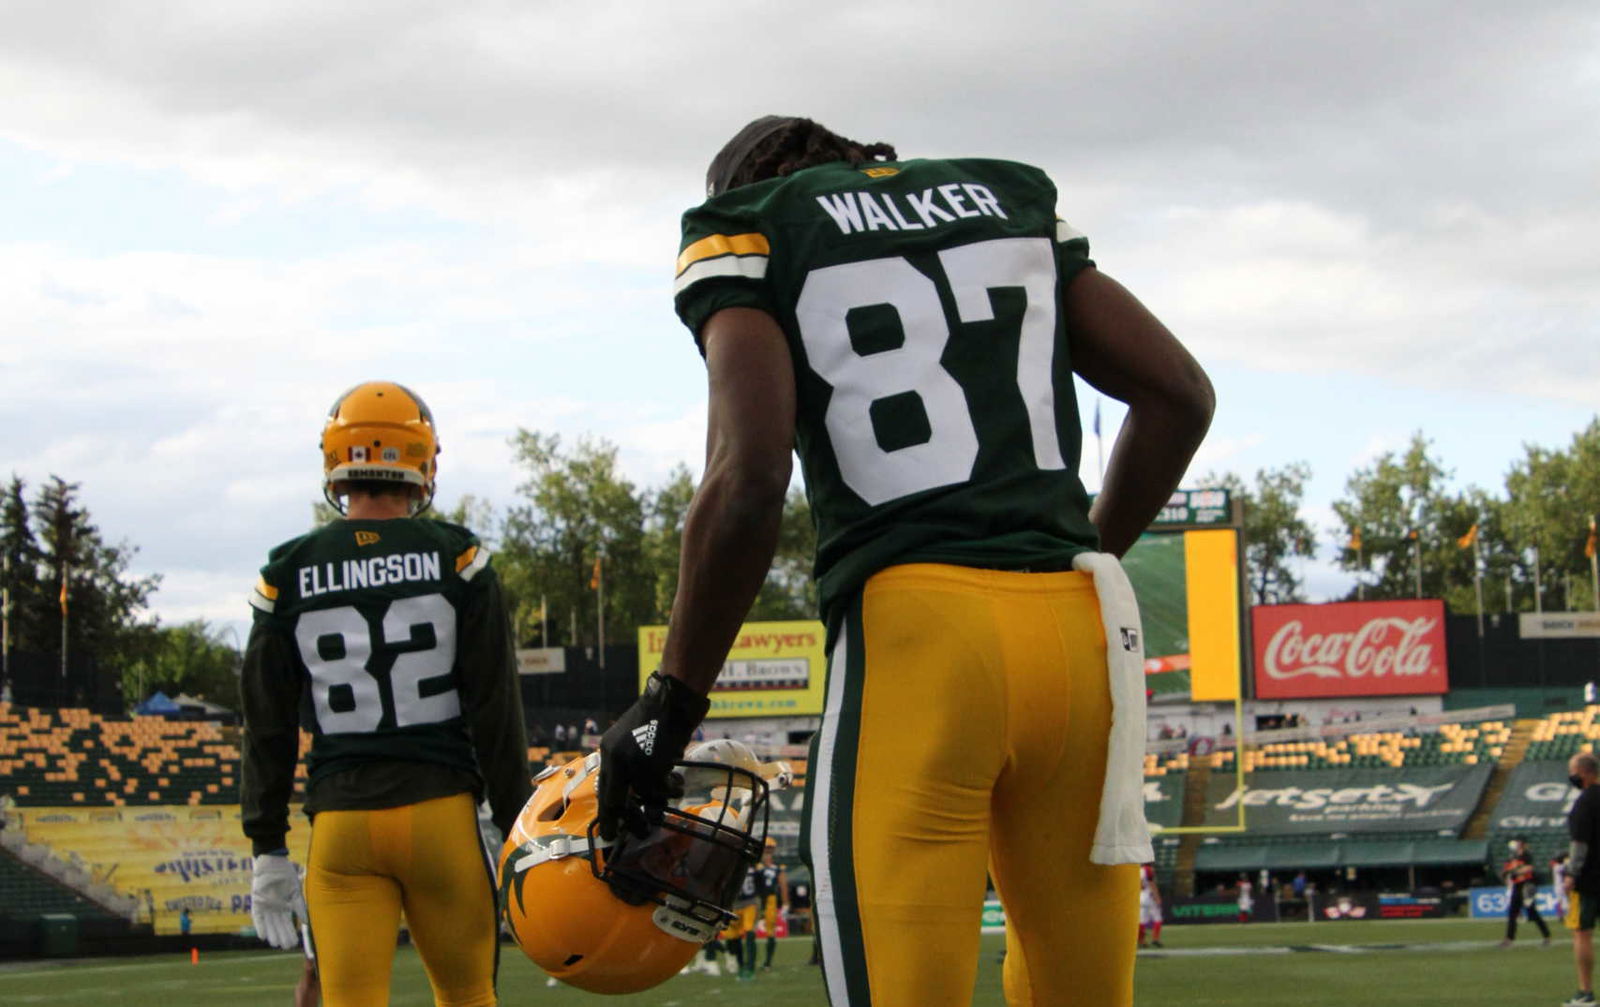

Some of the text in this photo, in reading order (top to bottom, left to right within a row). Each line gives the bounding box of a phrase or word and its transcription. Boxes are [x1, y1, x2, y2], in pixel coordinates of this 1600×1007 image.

[816, 182, 1008, 235] WALKER
[795, 237, 1067, 507] 87
[348, 468, 405, 479] EDMONTON
[299, 552, 441, 599] ELLINGSON
[294, 593, 461, 735] 82
[1264, 616, 1437, 678] Coca-Cola
[645, 719, 658, 756] adidas
